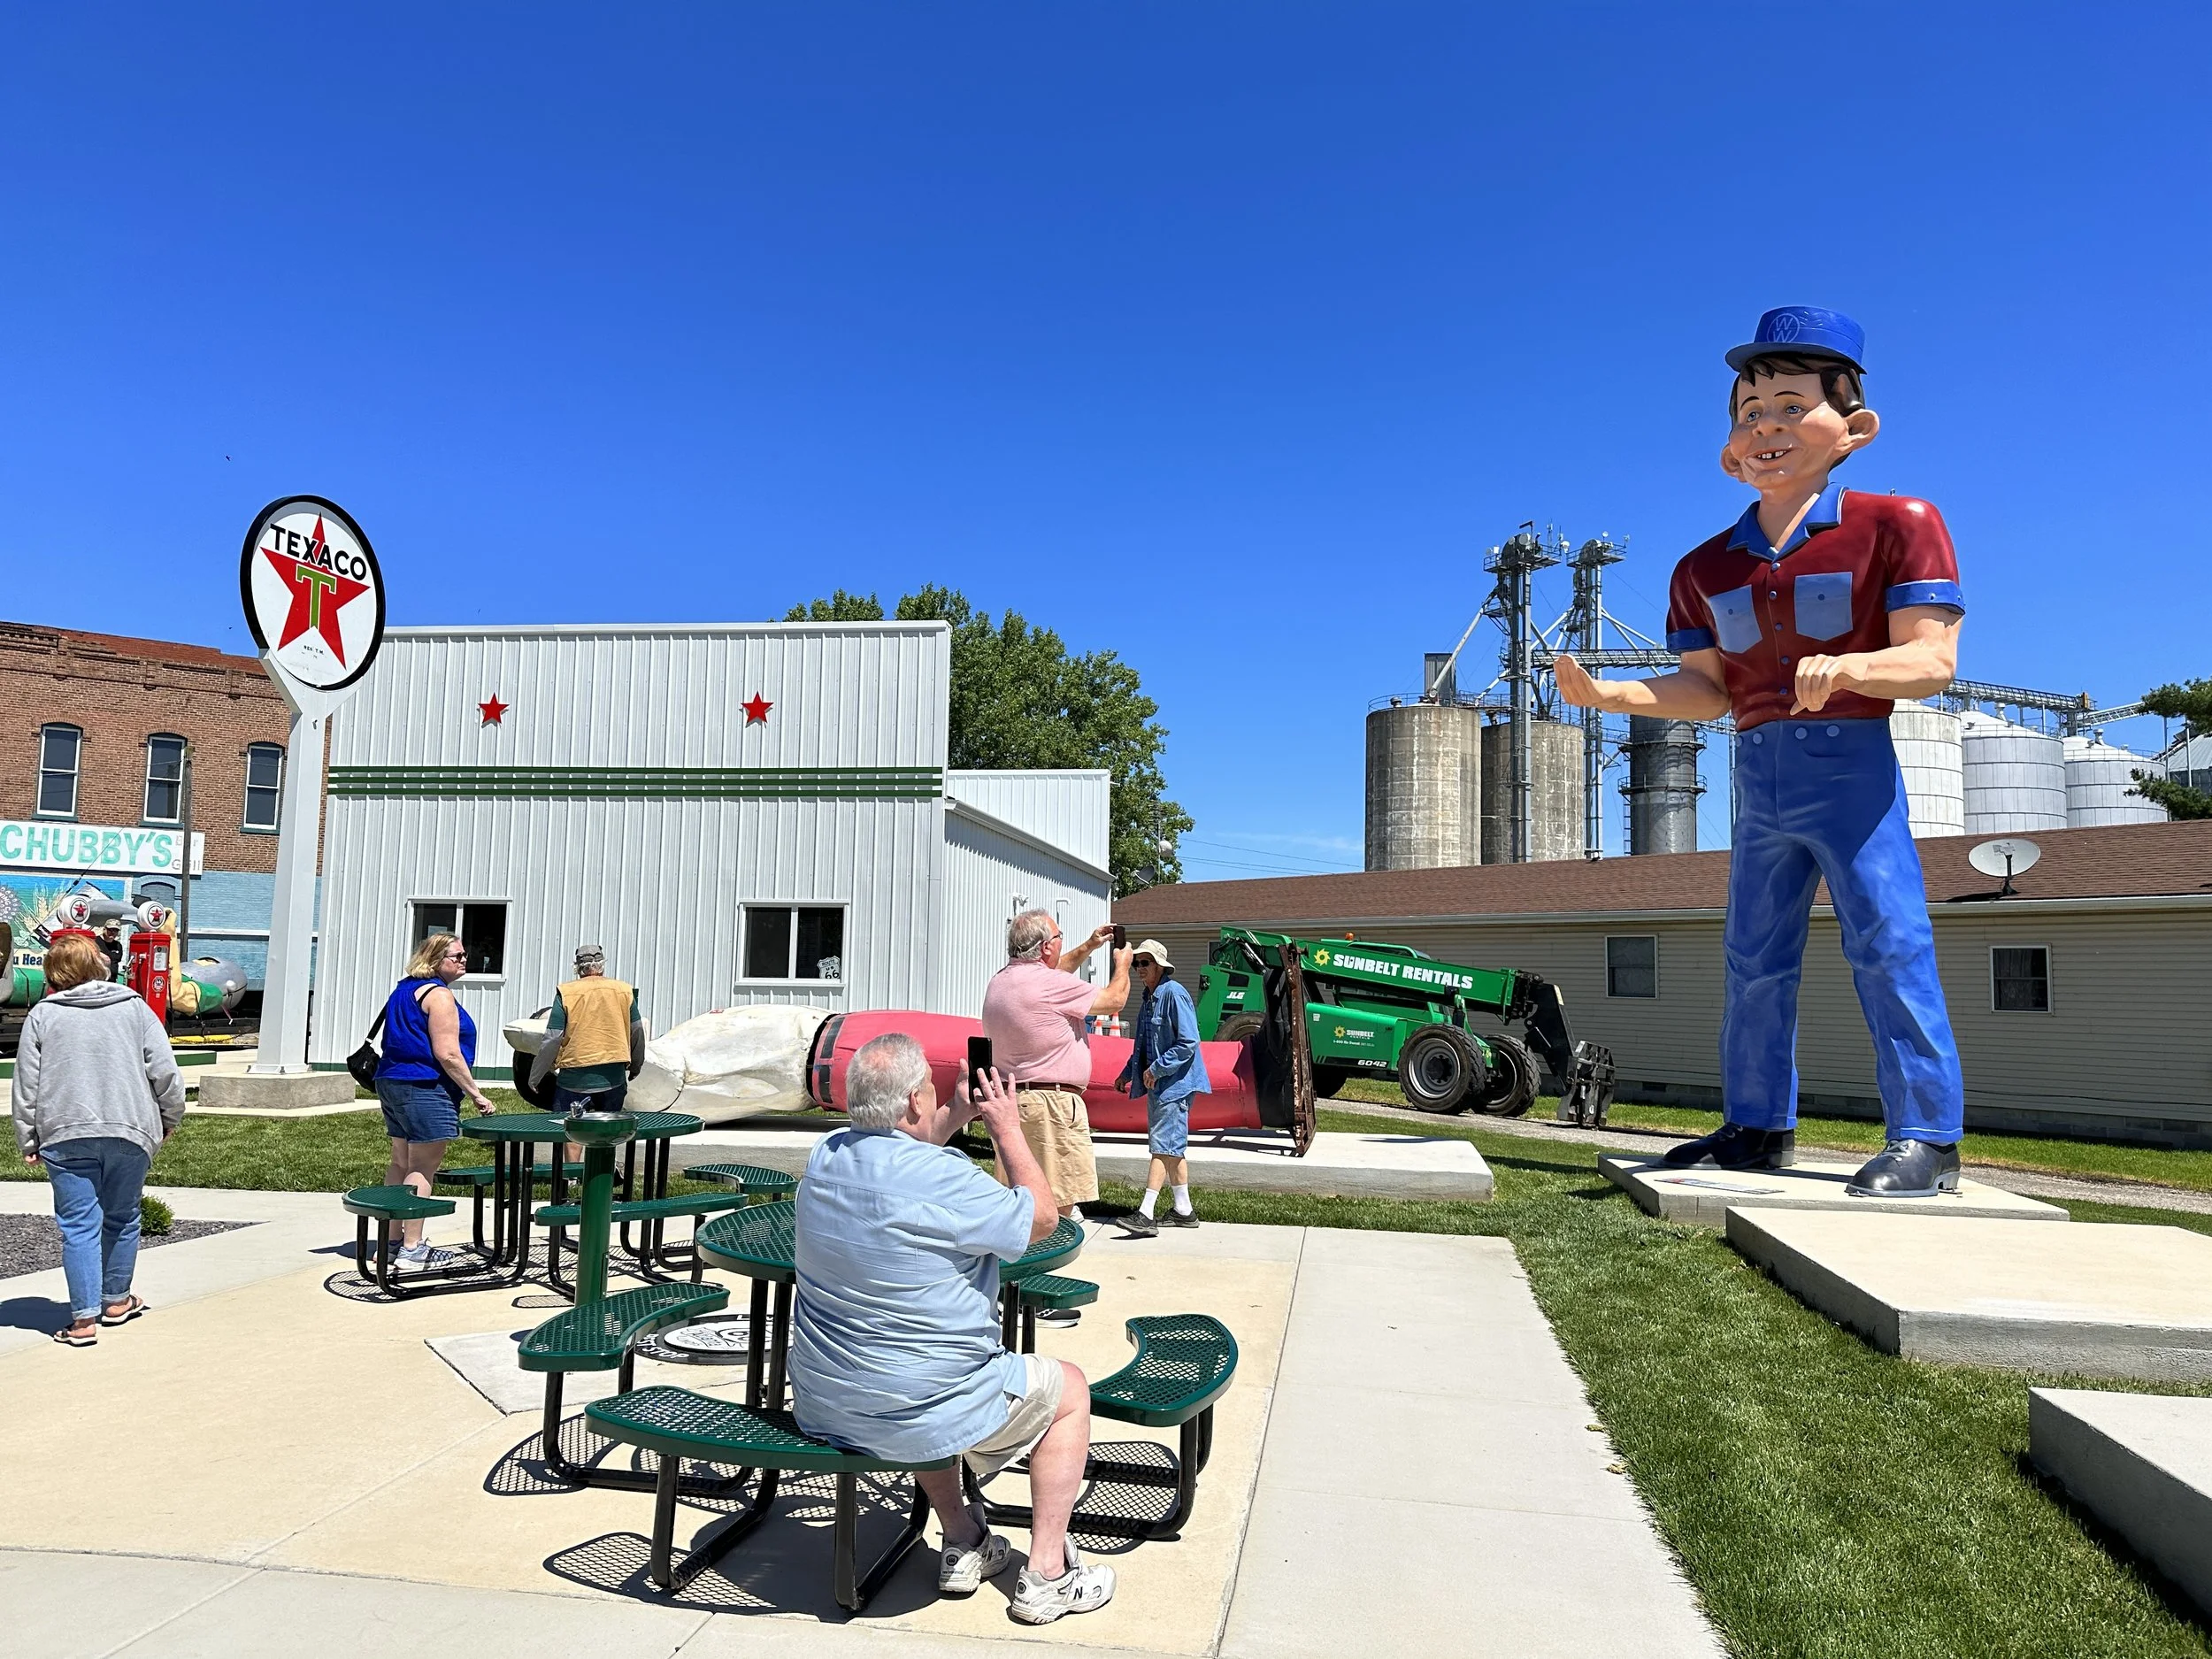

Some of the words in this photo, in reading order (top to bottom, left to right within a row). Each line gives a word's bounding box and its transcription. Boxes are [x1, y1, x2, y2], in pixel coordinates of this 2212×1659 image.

[270, 523, 366, 581] TEXACO
[296, 564, 337, 629] T
[0, 825, 173, 867] CHUBBY'S
[22, 953, 47, 965] Hea
[825, 970, 840, 979] 66
[1333, 953, 1401, 977] SUNBELT
[1402, 965, 1474, 990] RENTALS
[1226, 991, 1245, 1000] JLG
[1346, 1029, 1375, 1038] SUNBELT
[1357, 1059, 1387, 1068] 6042
[641, 1347, 690, 1359] STOP
[1073, 1586, 1083, 1601] N
